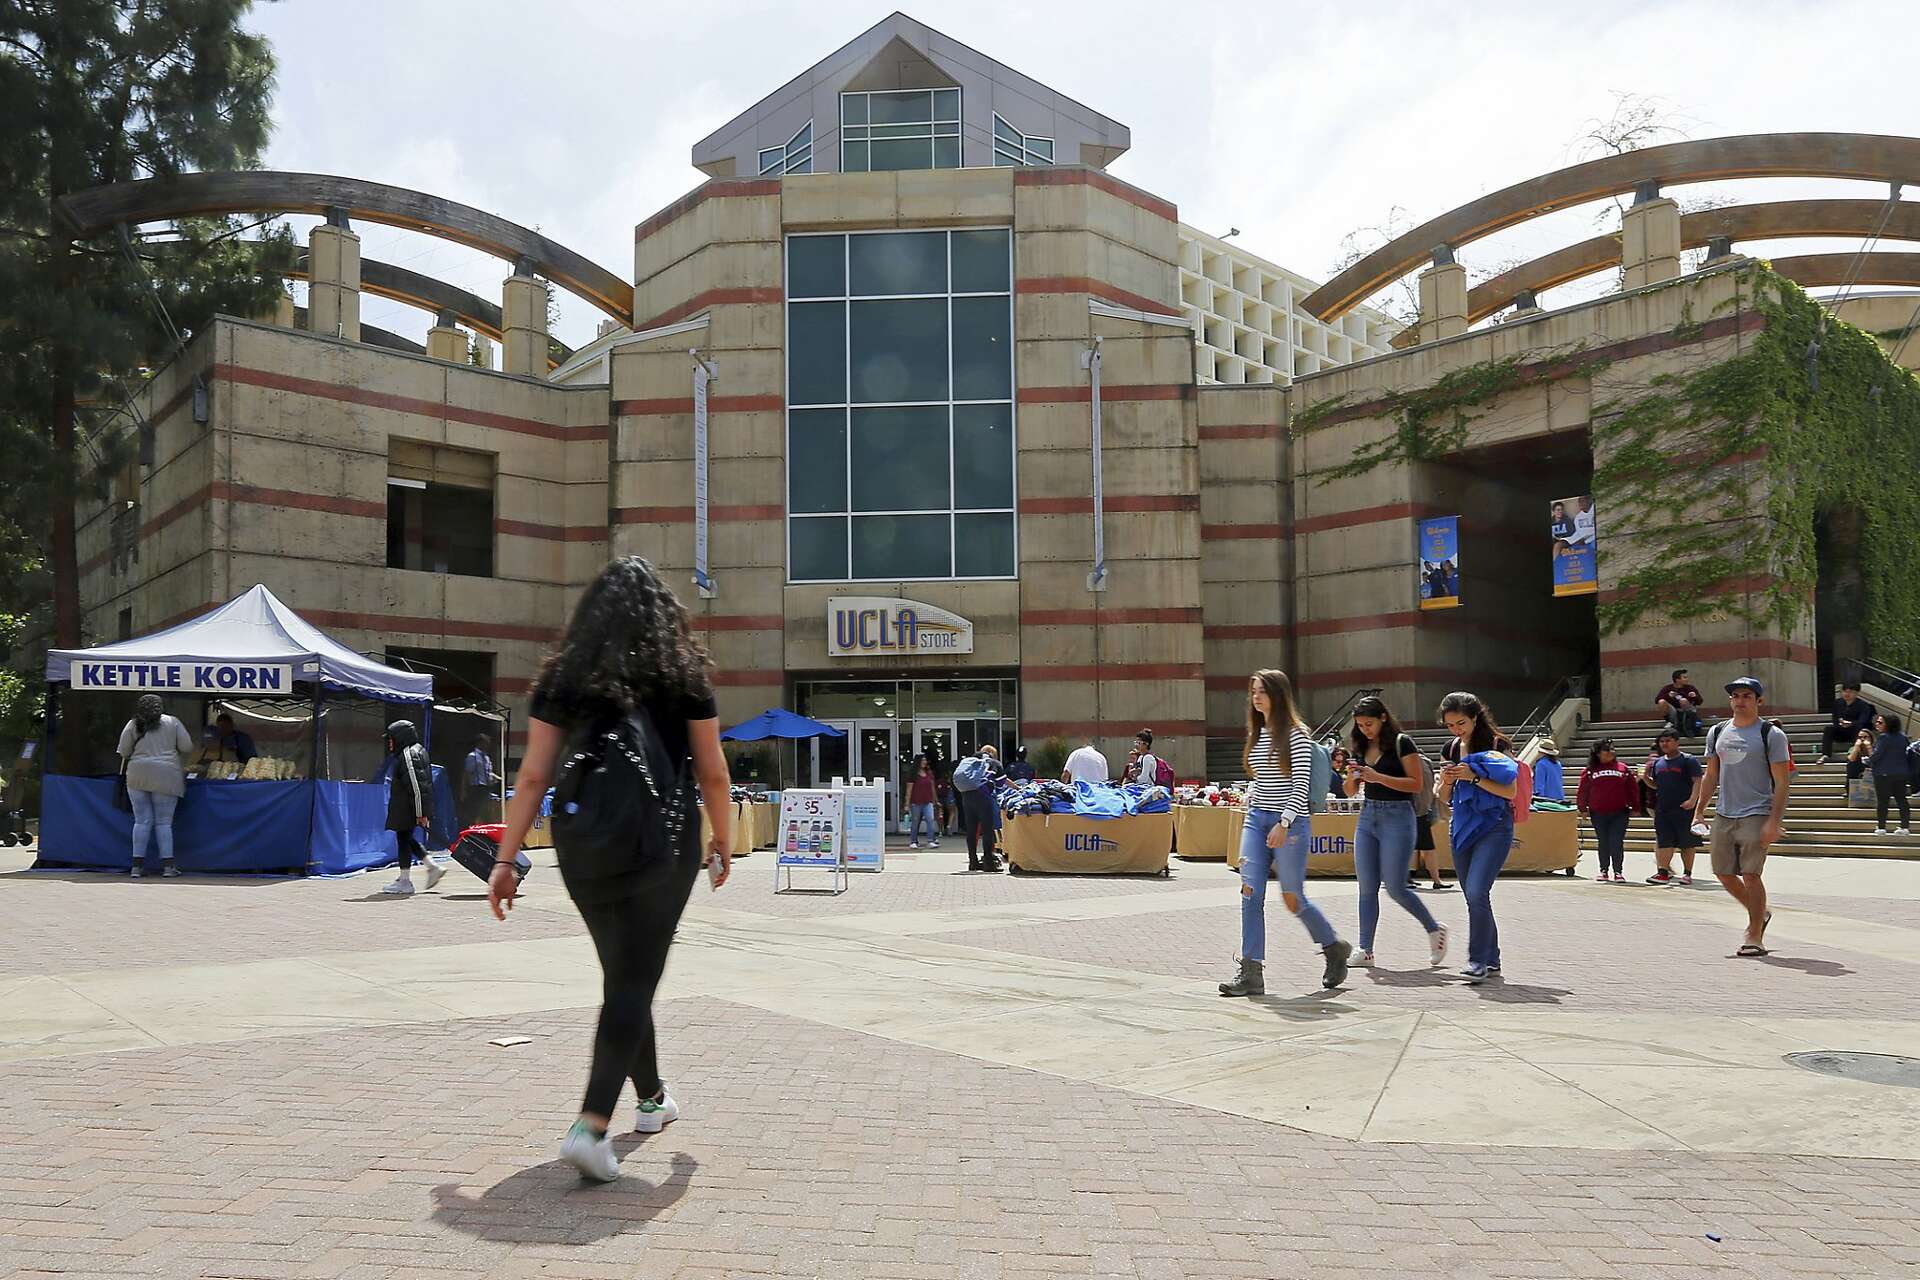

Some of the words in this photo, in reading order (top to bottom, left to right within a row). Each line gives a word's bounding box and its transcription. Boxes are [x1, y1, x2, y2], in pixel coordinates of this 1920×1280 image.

[836, 608, 919, 649] UCLA
[921, 632, 957, 648] STORE
[82, 664, 181, 687] KETTLE
[194, 666, 280, 689] KORN
[805, 801, 819, 814] $5
[1065, 833, 1100, 851] UCLA
[1310, 836, 1345, 854] UCLA
